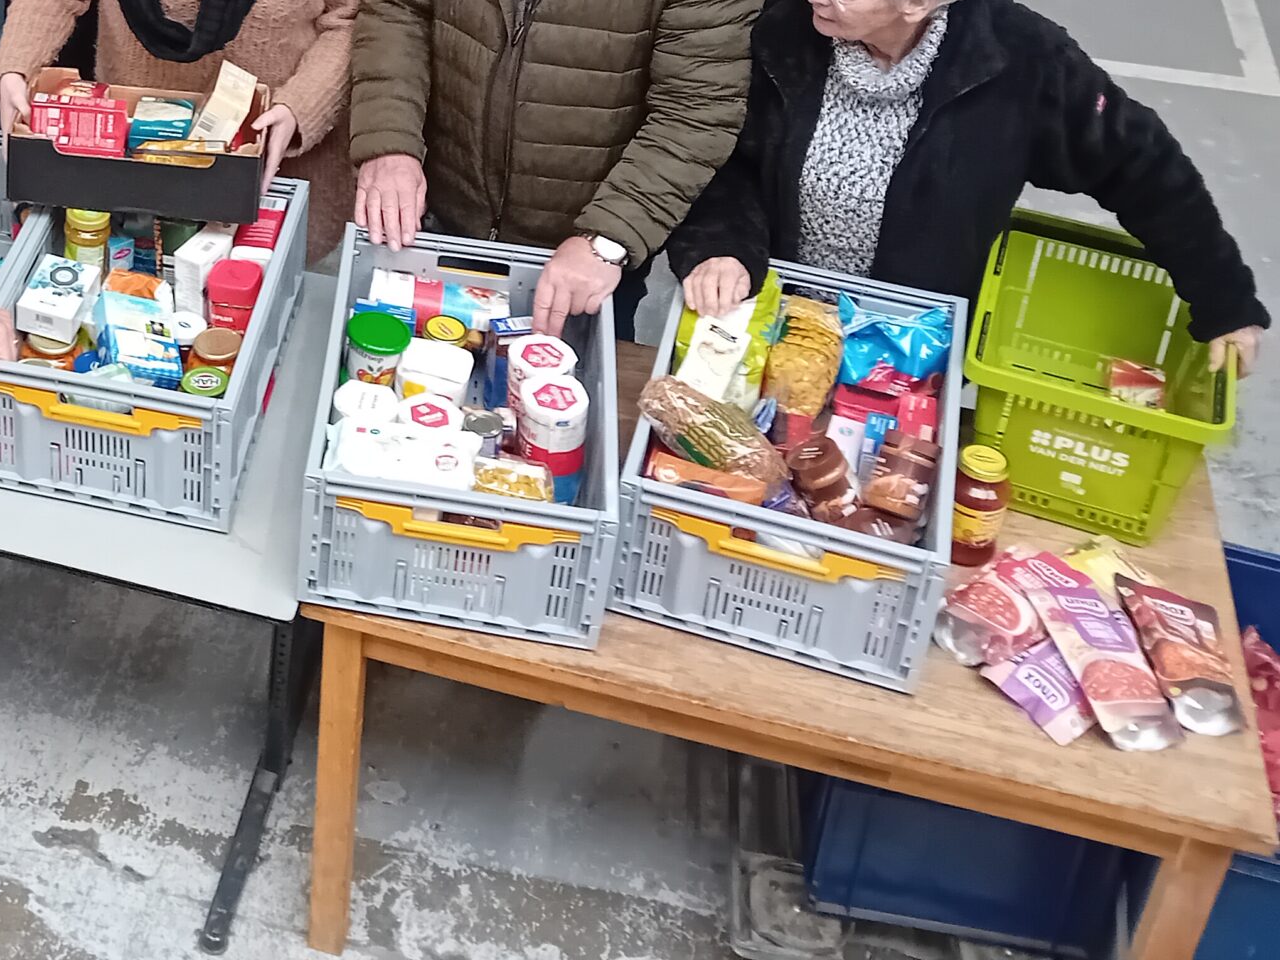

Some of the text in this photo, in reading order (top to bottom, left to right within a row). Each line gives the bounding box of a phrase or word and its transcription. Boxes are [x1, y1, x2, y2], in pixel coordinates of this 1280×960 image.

[1029, 444, 1057, 458] VAN
[1058, 452, 1087, 467] DER
[1053, 435, 1130, 467] PLUS
